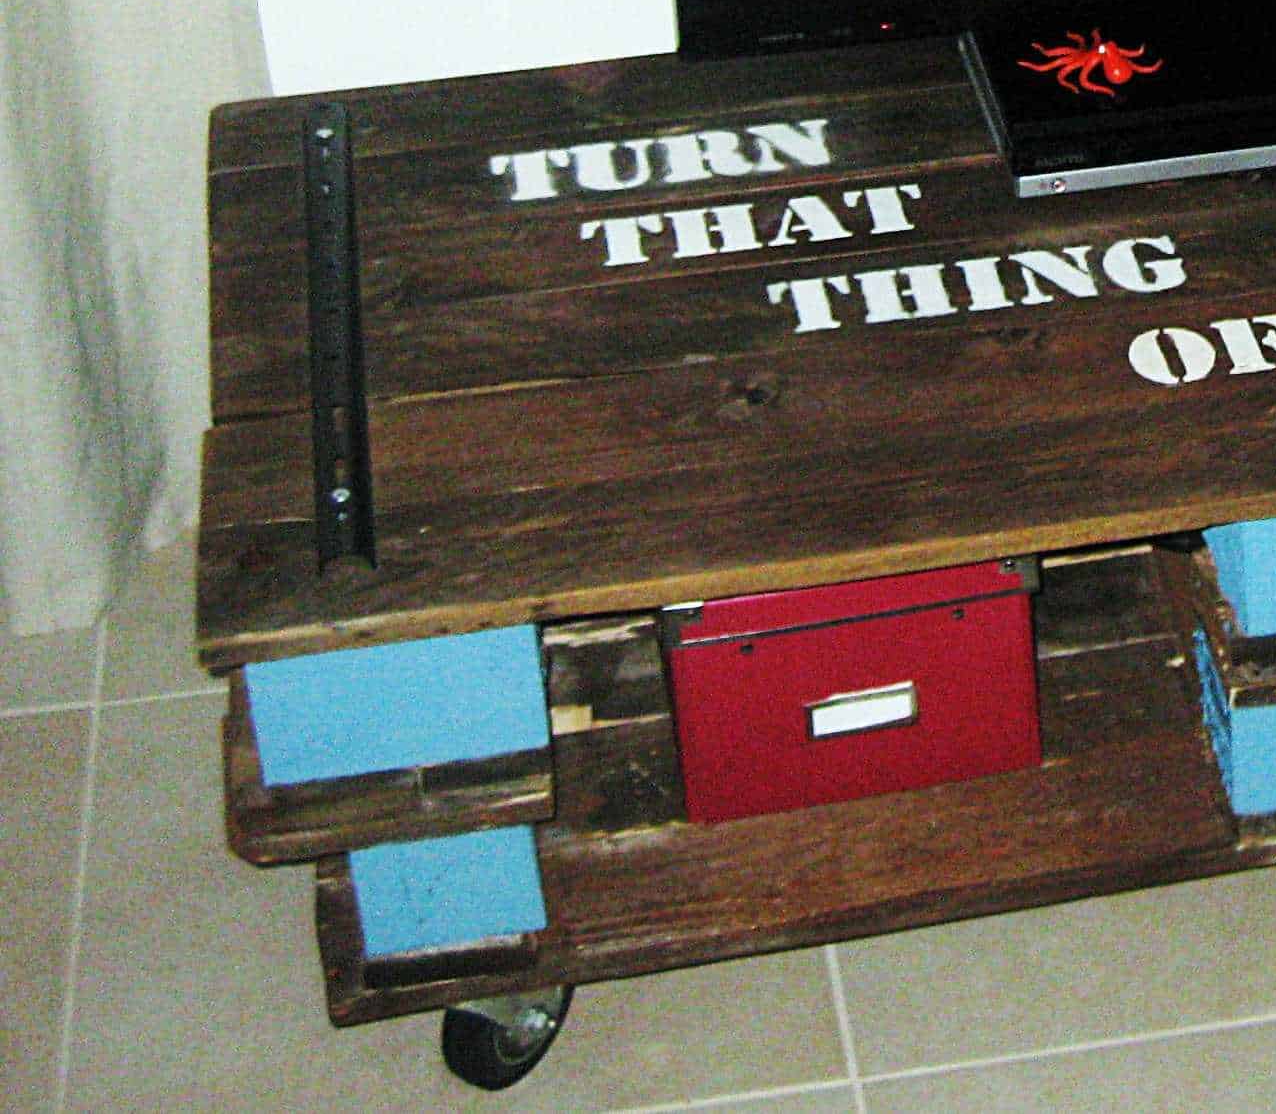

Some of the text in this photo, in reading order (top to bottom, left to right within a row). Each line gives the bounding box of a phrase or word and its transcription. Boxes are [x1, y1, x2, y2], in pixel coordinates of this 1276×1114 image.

[488, 118, 831, 202] TURN
[580, 183, 923, 266] THAT
[767, 234, 1187, 333] THING
